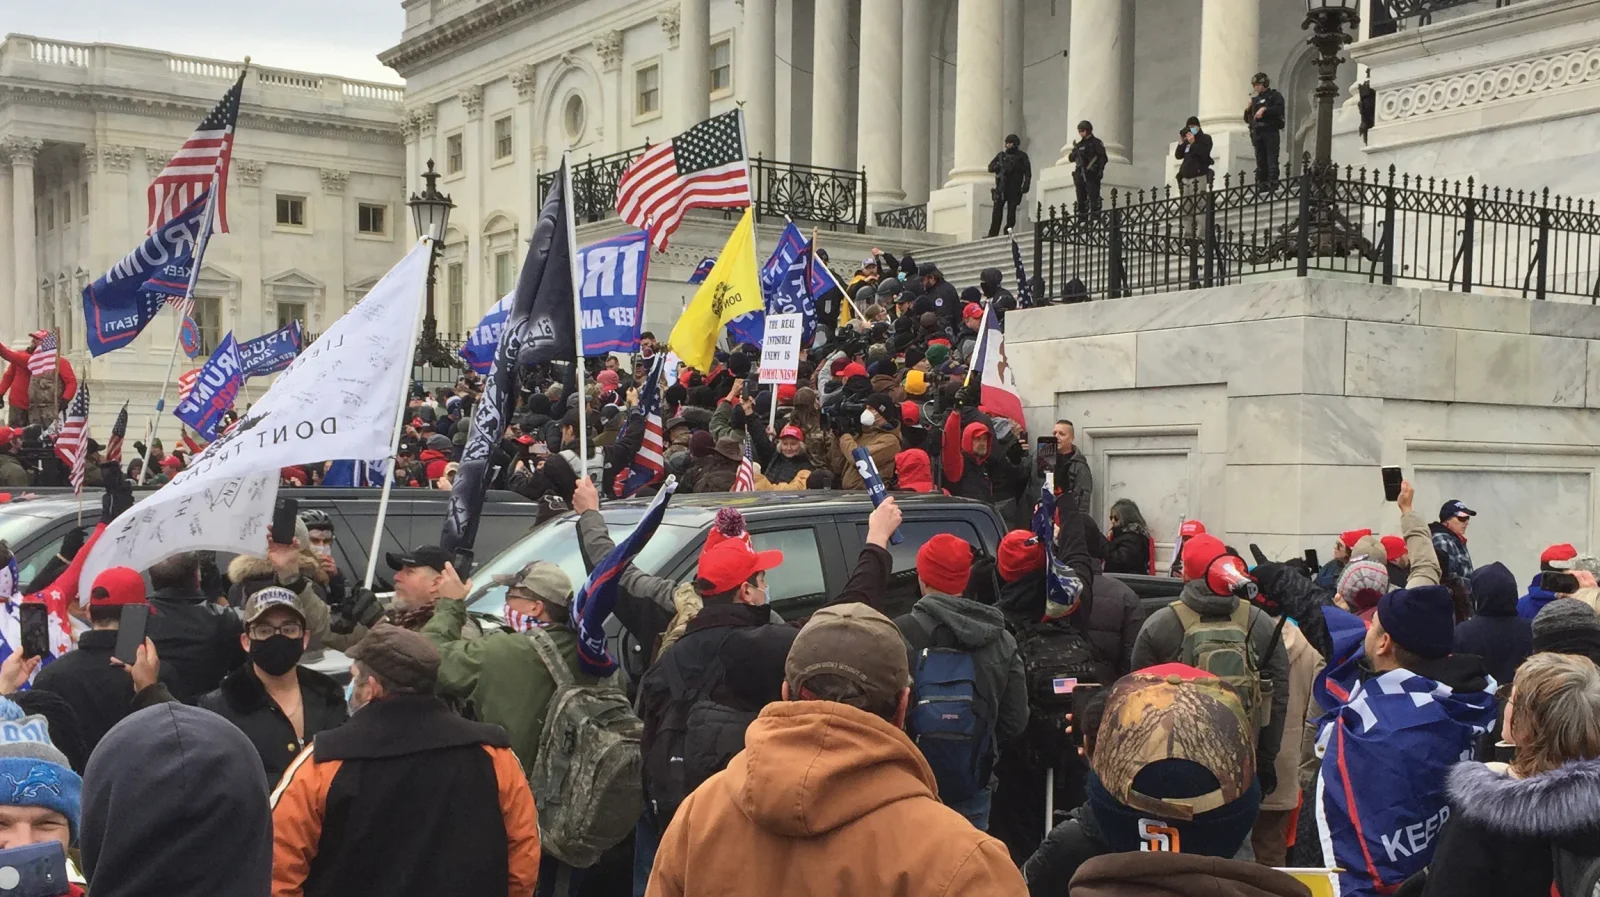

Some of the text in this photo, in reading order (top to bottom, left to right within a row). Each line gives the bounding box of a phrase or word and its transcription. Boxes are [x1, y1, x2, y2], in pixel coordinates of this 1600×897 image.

[769, 318, 795, 330] THE REAL
[766, 335, 792, 346] INVISIBLE
[764, 350, 791, 361] ENEMY IS
[759, 368, 797, 381] COMMUNISM
[1380, 805, 1451, 862] KEEP
